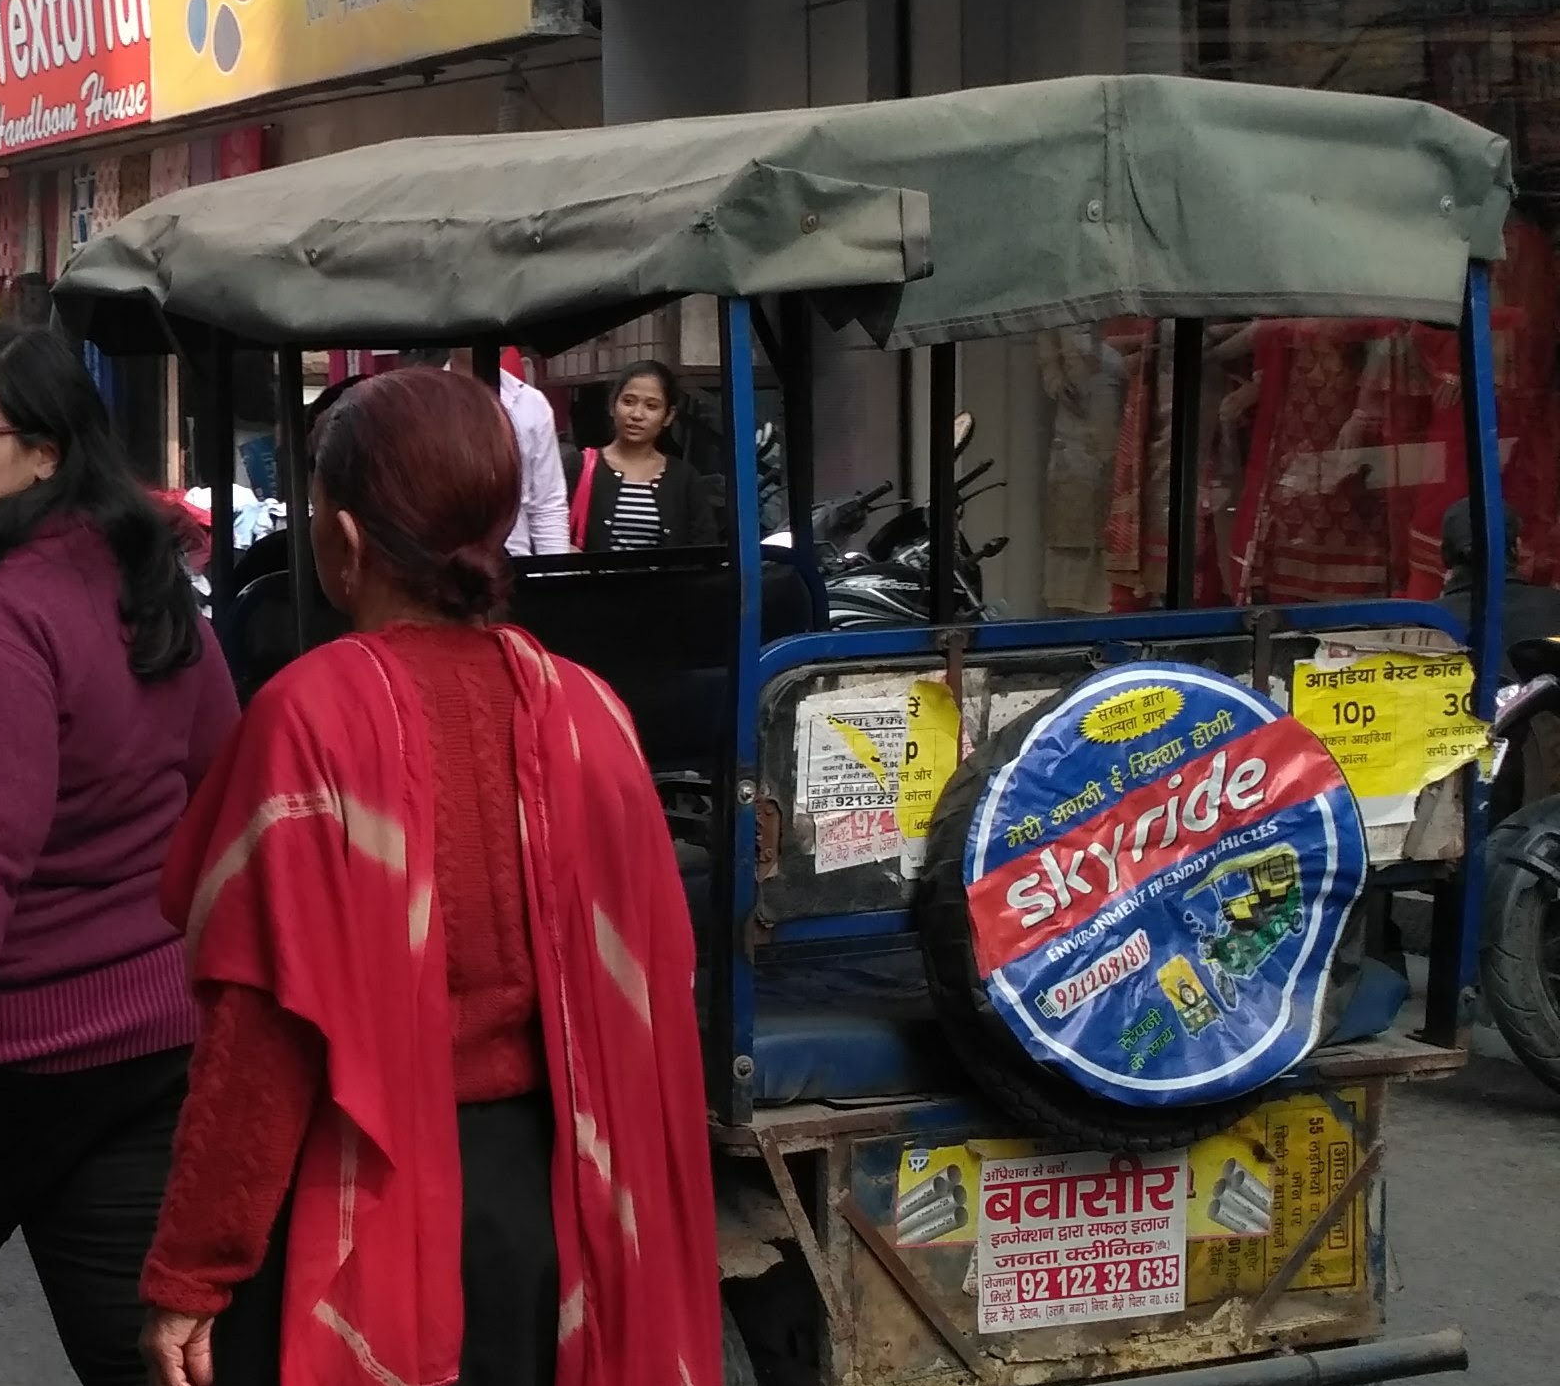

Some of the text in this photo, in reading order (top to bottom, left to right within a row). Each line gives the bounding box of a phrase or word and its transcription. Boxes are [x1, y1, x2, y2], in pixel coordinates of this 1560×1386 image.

[80, 70, 149, 129] House
[1305, 656, 1466, 689] आइडिया बेस्ट कॉल
[1096, 690, 1165, 722] सरकार द्वारा
[1332, 700, 1376, 728] 10p
[1101, 707, 1167, 738] मान्यता प्राप्त
[1351, 729, 1393, 746] आइडिया
[1425, 721, 1486, 740] अन्य लोकल
[1004, 812, 1046, 848] मेरी
[1049, 779, 1107, 826] अगली
[1189, 709, 1238, 749] होगी
[1006, 750, 1267, 929] skyride
[1046, 888, 1146, 963] ENVIRONMENT
[1308, 1115, 1325, 1135] 55
[1272, 1124, 1290, 1161] हिन्दी
[1032, 1162, 1043, 1177] से
[1273, 1164, 1290, 1178] में
[983, 1153, 1180, 1225] बवासीर
[1273, 1182, 1286, 1211] बात
[1290, 1170, 1304, 1227] फोन पर
[990, 1216, 1170, 1248] इन्जेक्शन द्वारा सफल इलाज
[994, 1249, 1060, 1269] जनता
[1065, 1238, 1154, 1262] क्लीनिक
[984, 1273, 1017, 1290] रोजाना
[1021, 1256, 1179, 1301] 92 122 32 635
[990, 1289, 1013, 1303] मिलें
[1164, 1291, 1180, 1305] 652
